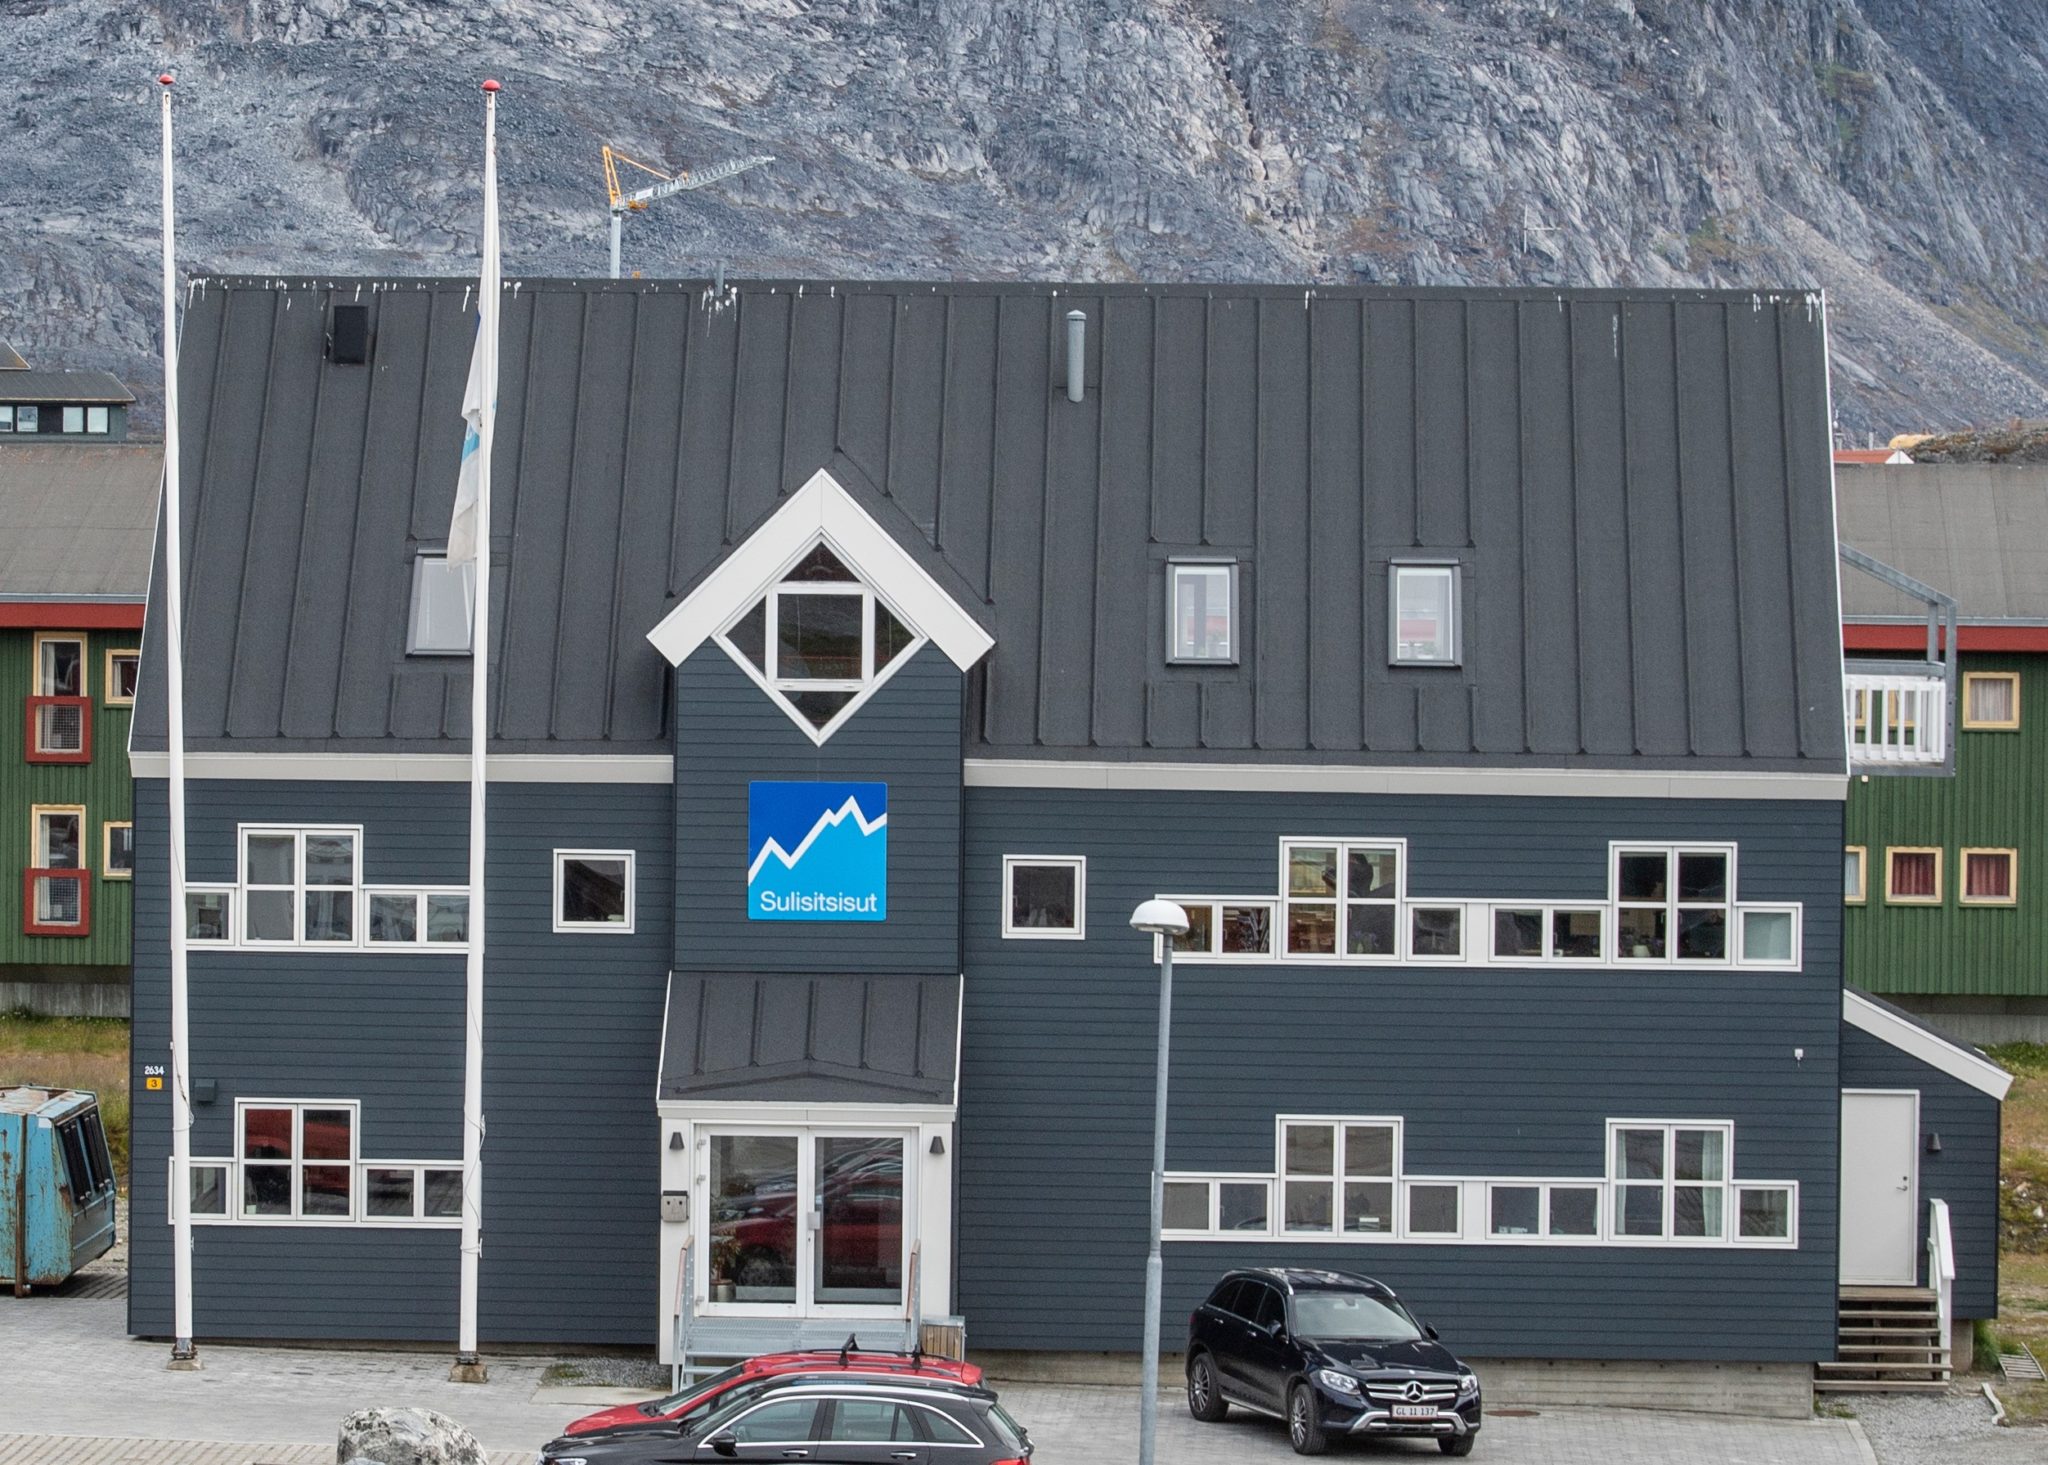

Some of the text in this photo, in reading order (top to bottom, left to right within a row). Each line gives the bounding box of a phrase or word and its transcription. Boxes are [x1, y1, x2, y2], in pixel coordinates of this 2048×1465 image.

[760, 890, 877, 912] Sulisitsisut
[144, 1065, 164, 1075] 2634
[1396, 1407, 1435, 1416] GL 11 137
